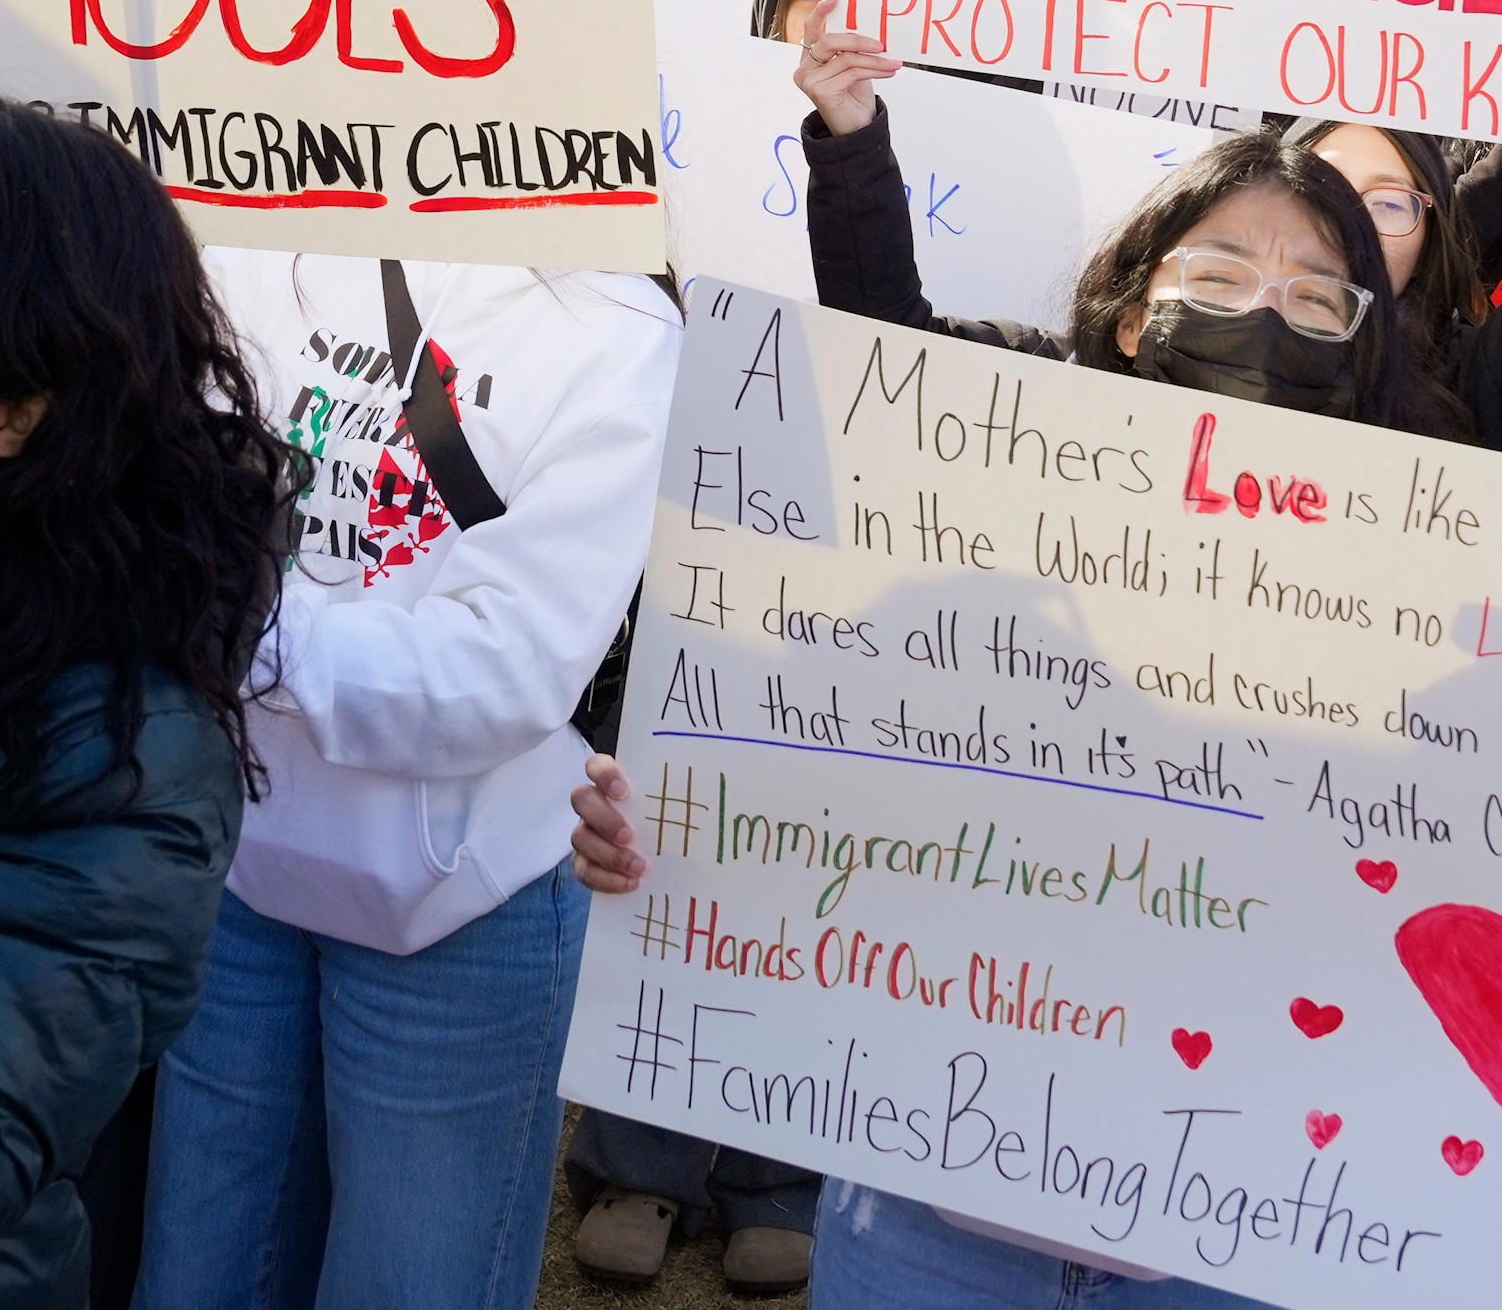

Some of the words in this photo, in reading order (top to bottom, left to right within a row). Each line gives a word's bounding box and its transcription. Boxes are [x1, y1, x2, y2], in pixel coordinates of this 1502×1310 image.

[406, 121, 656, 196] CHILDREN
[1279, 22, 1427, 121] OUR
[844, 335, 1153, 494] Mother's
[1183, 411, 1327, 523] Love
[1345, 489, 1380, 525] is
[1402, 457, 1481, 548] like
[298, 515, 383, 568] PAIS
[690, 445, 819, 541] Else
[853, 474, 892, 556] in
[913, 491, 996, 570] the
[1195, 539, 1224, 601] it
[1395, 594, 1443, 648] no
[660, 647, 724, 732] All
[759, 673, 850, 750] that
[871, 698, 1011, 766] stands
[1029, 724, 1065, 778] in
[1307, 760, 1452, 849] Agatha
[670, 562, 737, 630] It
[761, 575, 880, 658] dares
[904, 610, 957, 672] all
[985, 615, 1111, 710] things
[1136, 653, 1215, 708] and
[1234, 673, 1360, 729] crushes
[1385, 688, 1479, 755] down
[616, 979, 1441, 1273] #FamiliesBelongTogether
